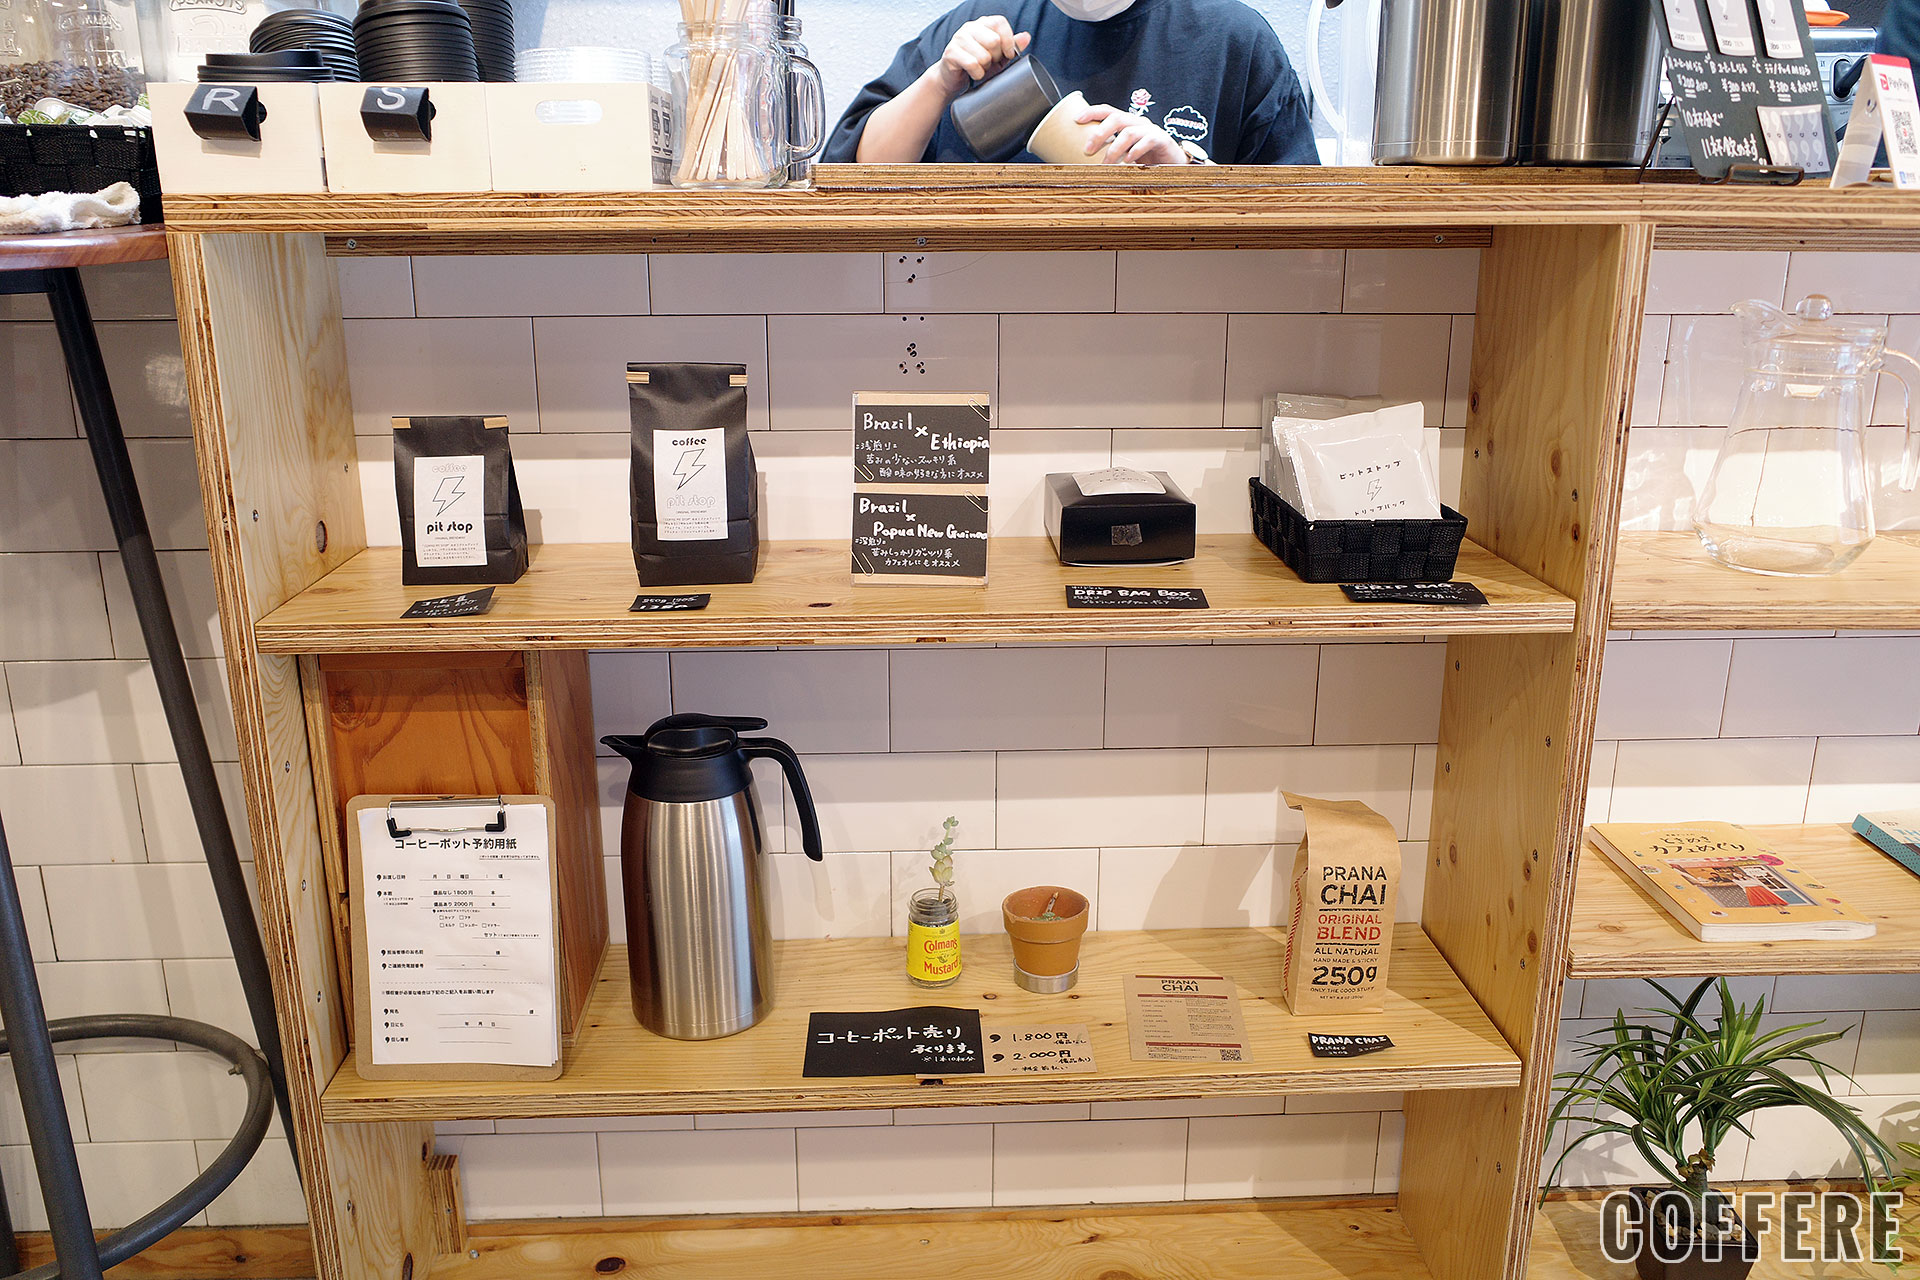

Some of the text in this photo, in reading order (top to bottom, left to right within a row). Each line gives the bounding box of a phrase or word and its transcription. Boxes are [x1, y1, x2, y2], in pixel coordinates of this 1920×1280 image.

[202, 87, 241, 112] R
[376, 86, 409, 111] S
[863, 412, 913, 431] Brazil
[671, 437, 708, 447] coffee
[930, 433, 989, 453] Ethiopia
[432, 463, 468, 474] coffee
[666, 495, 717, 509] pit stop
[859, 497, 907, 514] Brazil
[426, 520, 473, 535] pit stop
[873, 521, 915, 540] Papua
[917, 524, 944, 538] New
[1074, 589, 1113, 597] DRIP
[1117, 589, 1151, 597] BAG
[394, 837, 518, 851] コーヒーポット予約用紙
[1649, 843, 1746, 855] カフェめぐり
[1322, 865, 1388, 882] PRANA
[1320, 883, 1387, 906] CHAI
[1317, 913, 1383, 926] ORIGINAL
[1316, 926, 1382, 941] BLEND
[1314, 947, 1379, 956] ALL NATURAL
[1311, 965, 1378, 987] 250g
[1162, 984, 1200, 992] CHAI
[816, 1024, 962, 1045] コーヒーポット売り
[1311, 1035, 1354, 1046] PRANA
